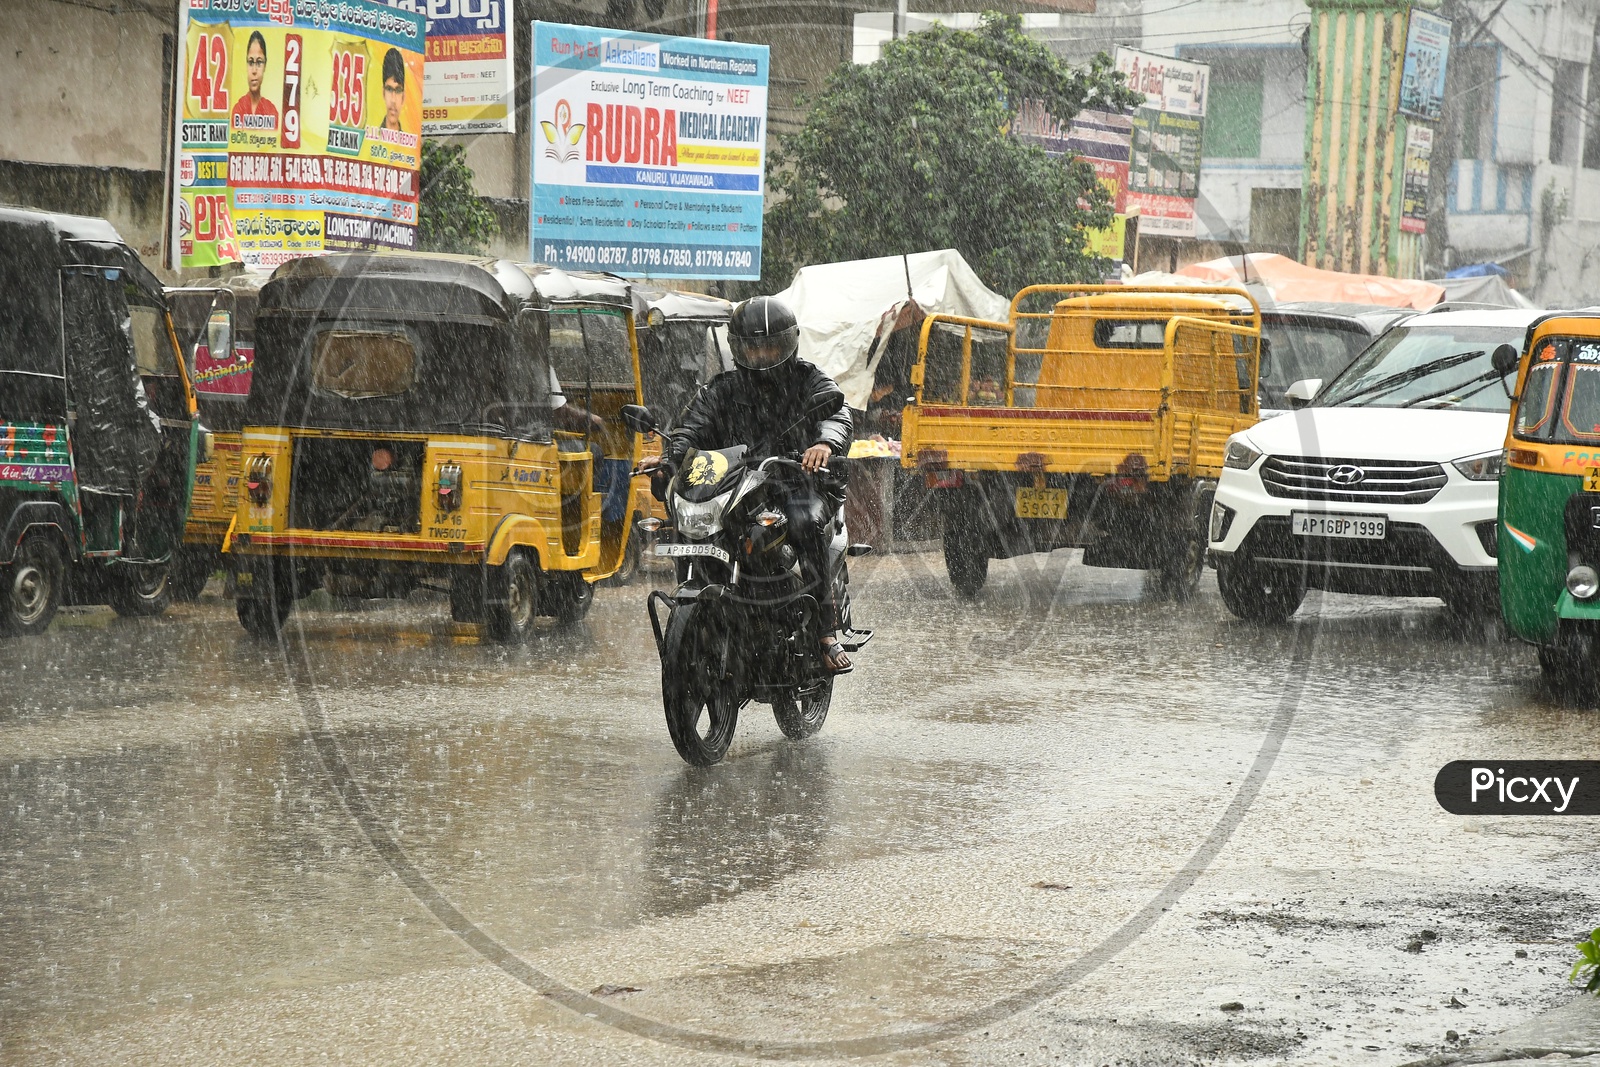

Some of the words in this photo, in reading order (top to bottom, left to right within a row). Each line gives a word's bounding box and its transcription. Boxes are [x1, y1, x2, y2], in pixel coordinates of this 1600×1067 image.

[443, 40, 457, 56] IIT
[551, 38, 570, 54] Run
[573, 41, 584, 60] by
[587, 42, 598, 58] Ex
[605, 41, 656, 68] Aakashians
[662, 52, 689, 67] Worked
[690, 57, 698, 68] in
[698, 57, 728, 71] Northern
[729, 60, 756, 74] Regions
[192, 35, 227, 110] 42
[480, 70, 496, 78] NEET
[591, 80, 620, 92] Exclusive
[622, 78, 646, 100] Long
[648, 81, 670, 98] Term
[672, 84, 714, 106] Coaching
[716, 92, 724, 102] for
[727, 88, 750, 104] NEET
[422, 109, 448, 119] 5699
[235, 116, 242, 127] B.
[244, 116, 275, 129] NANDINI
[182, 124, 206, 142] STATE
[210, 125, 228, 142] RANK
[340, 131, 359, 150] RANK
[586, 102, 678, 166] RUDRA
[680, 111, 717, 139] MEDICAL
[719, 114, 761, 142] ACADEMY
[636, 171, 669, 186] KANURU,
[670, 174, 714, 187] VIJAYAWADA
[272, 194, 296, 205] MBBS
[392, 204, 412, 218] 55-60
[564, 196, 580, 206] Stress
[582, 196, 594, 206] Free
[596, 197, 624, 208] Education
[640, 200, 662, 210] Personal
[664, 200, 678, 210] Care
[684, 202, 710, 214] Mentoring
[712, 202, 720, 212] the
[720, 204, 742, 214] Students
[544, 214, 574, 225] Residential
[580, 216, 594, 226] Semi
[595, 217, 625, 227] Residential
[632, 218, 642, 230] Day
[668, 220, 686, 232] Facility
[692, 222, 710, 232] Follows
[712, 222, 726, 232] exact
[327, 216, 370, 239] LONGTERM
[372, 222, 414, 246] COACHING
[544, 244, 558, 262] Ph
[566, 246, 596, 263] 94900
[598, 247, 630, 266] 08787,
[632, 248, 660, 266] 81798
[662, 249, 693, 268] 67850,
[695, 250, 722, 266] 81798
[724, 250, 752, 268] 67840
[434, 514, 447, 524] AP
[451, 515, 462, 526] 16
[1302, 518, 1384, 536] AP16DP1999
[428, 527, 467, 540] TW5007
